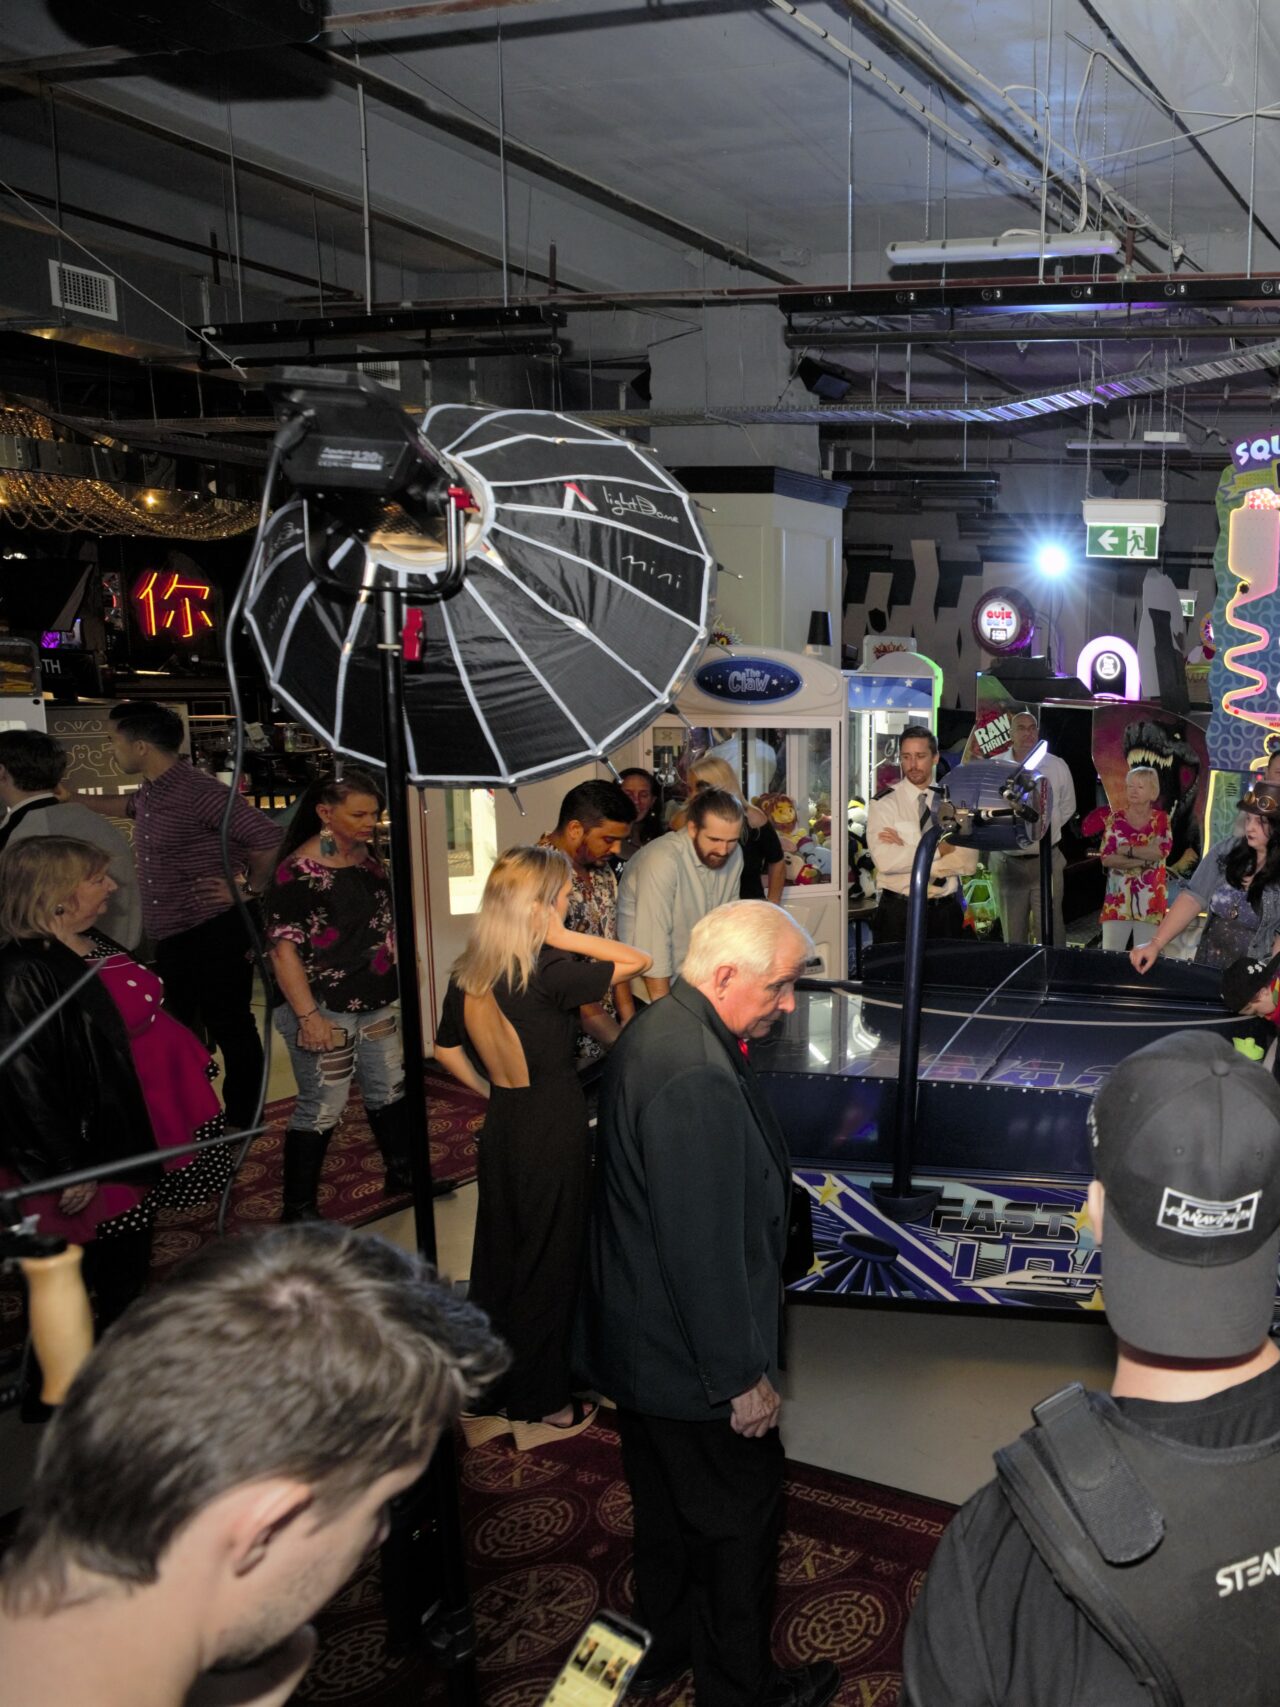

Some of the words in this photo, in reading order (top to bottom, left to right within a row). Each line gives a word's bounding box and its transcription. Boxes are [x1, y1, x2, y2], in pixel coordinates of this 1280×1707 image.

[621, 555, 682, 589] mini
[138, 572, 213, 638] 你
[728, 671, 771, 693] Claw
[745, 668, 761, 679] The
[974, 713, 1012, 745] RAW
[980, 729, 1013, 755] THRILL
[931, 1198, 1076, 1237] FAST
